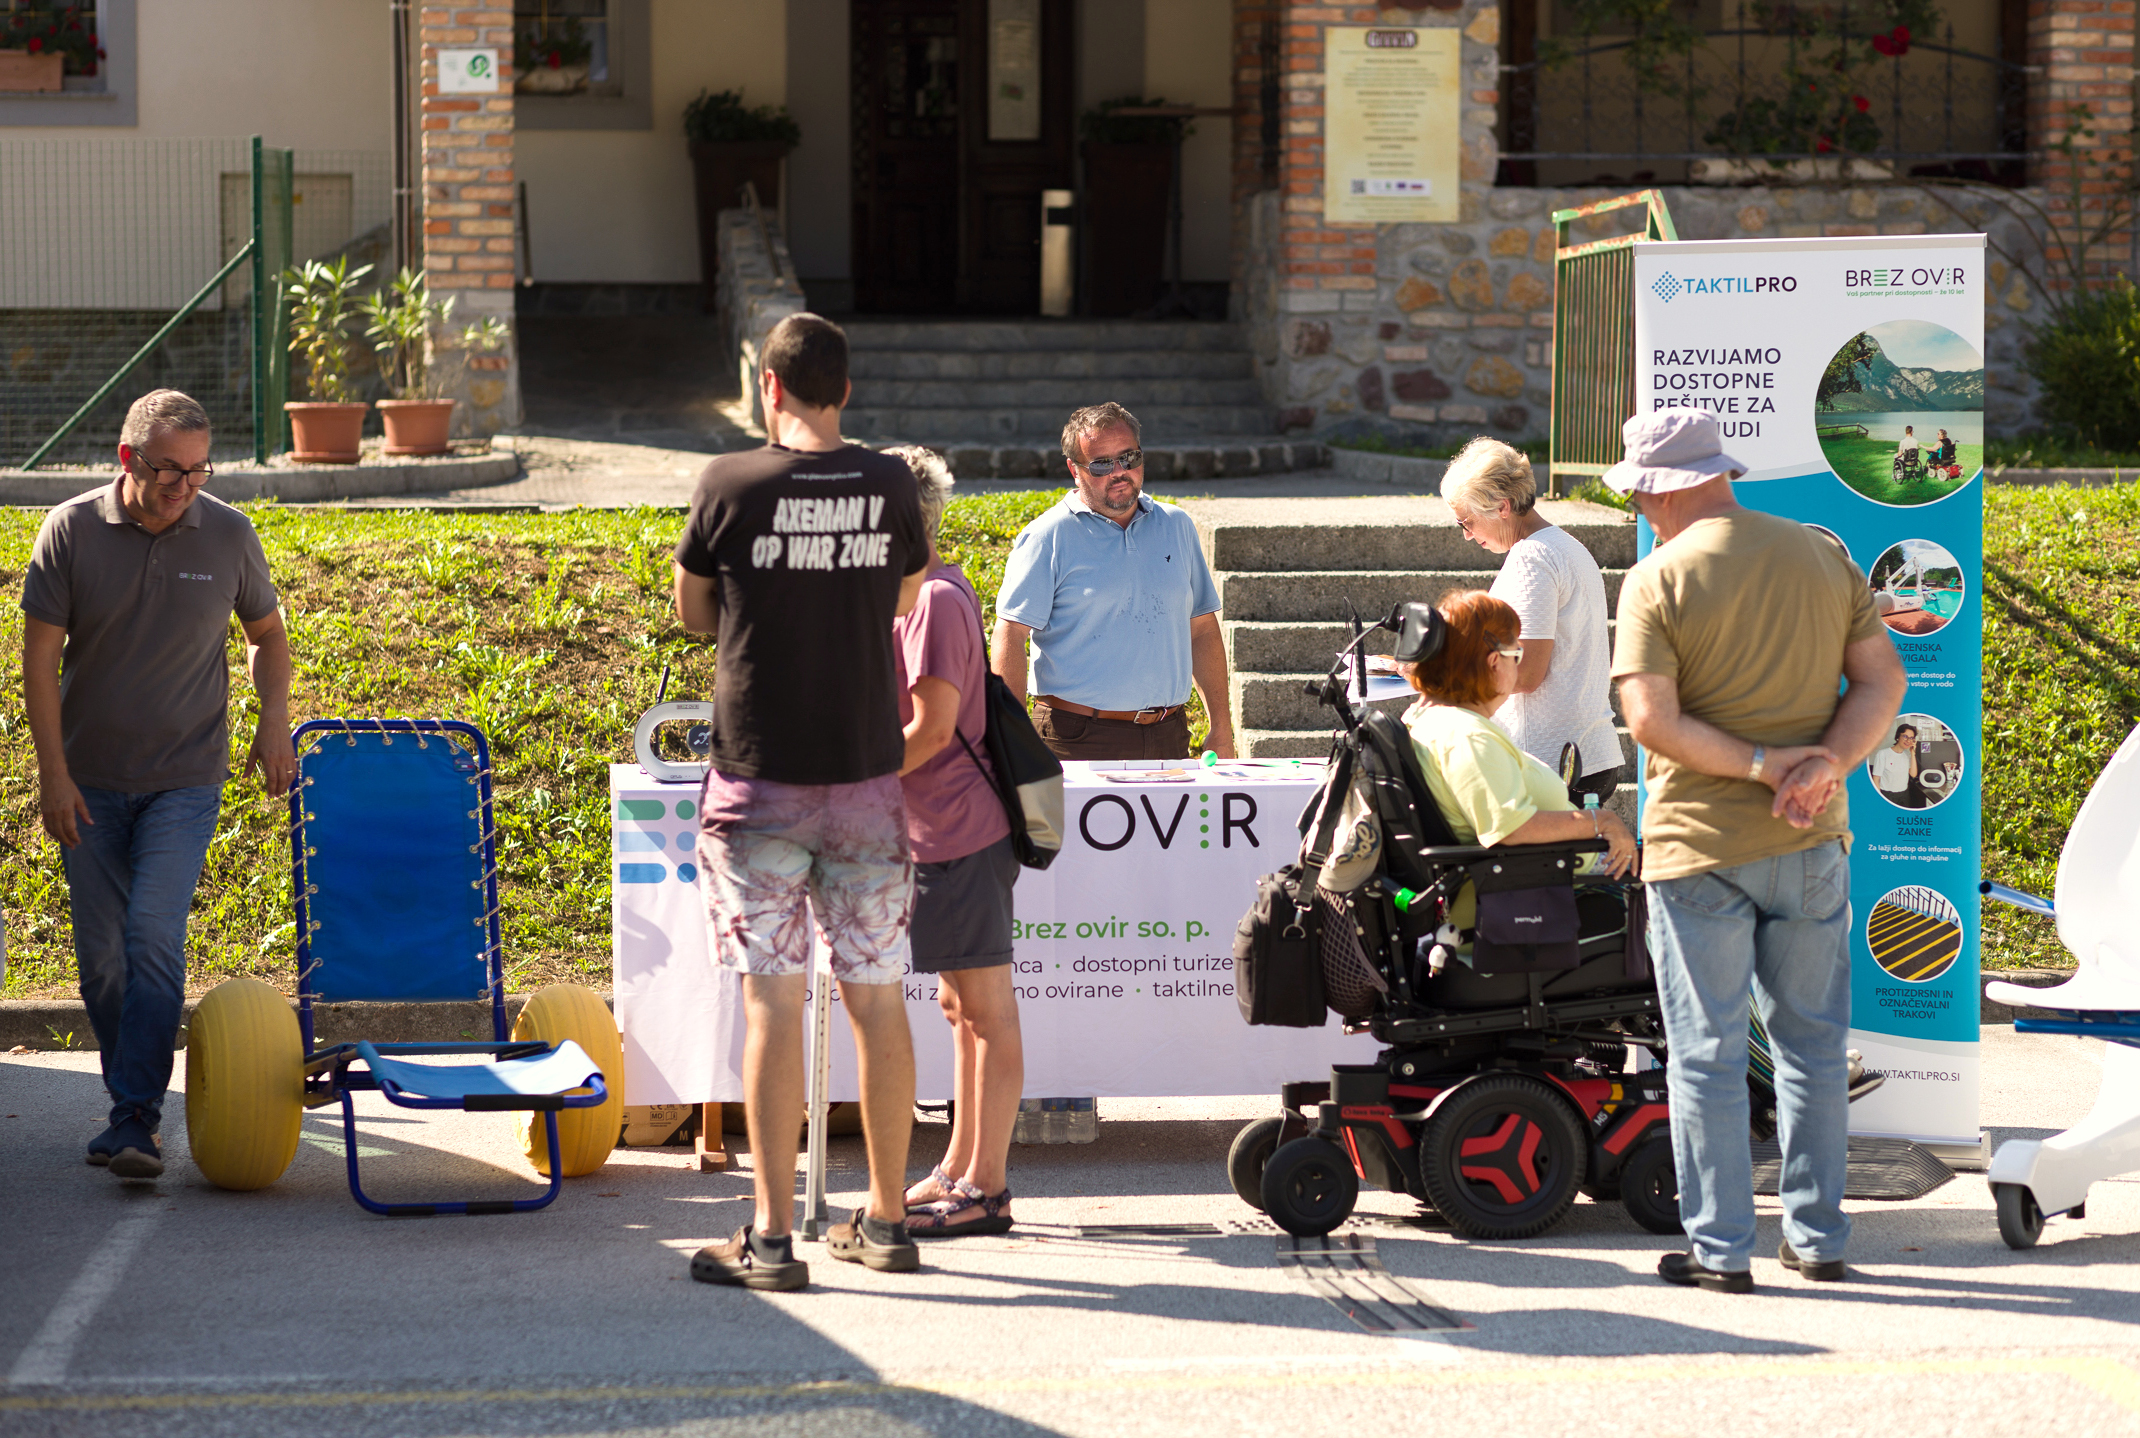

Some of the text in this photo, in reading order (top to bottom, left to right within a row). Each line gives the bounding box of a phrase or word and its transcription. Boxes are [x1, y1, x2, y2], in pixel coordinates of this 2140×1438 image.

[1846, 269, 1904, 287] BREZ
[1683, 276, 1798, 294] TAKTILPRO
[1846, 289, 1859, 297] Vaš
[1895, 289, 1933, 297] dostopnosti
[1653, 347, 1782, 366] RAZVIJAMO
[1653, 372, 1775, 390] DOSTOPNE
[1747, 397, 1776, 413] ZA
[772, 494, 886, 533] AXEMAN V
[751, 533, 893, 572] OP WAR ZONE
[1920, 671, 1945, 680] dostop
[1946, 671, 1957, 679] do
[1911, 680, 1929, 689] vstop
[1936, 680, 1955, 688] vodo
[1896, 815, 1934, 826] SLUŠNE
[1897, 827, 1932, 837] ZANKE
[1878, 844, 1891, 853] lažji
[1892, 845, 1916, 853] dostop
[1928, 846, 1962, 855] informacij
[1889, 853, 1909, 862] gluhe
[1918, 854, 1949, 863] naglušne
[1012, 915, 1210, 943] Brez ovir so. p.
[1072, 953, 1234, 976] dostopni turize
[1045, 981, 1124, 999] ovirane
[1152, 979, 1235, 998] taktilne
[1875, 987, 1953, 999] PROTIZDRSNI IN
[1879, 997, 1950, 1009] OZNAČEVALNI
[1893, 1009, 1936, 1019] TRAKOVI
[1593, 1111, 1609, 1126] M5
[679, 1130, 689, 1141] M
